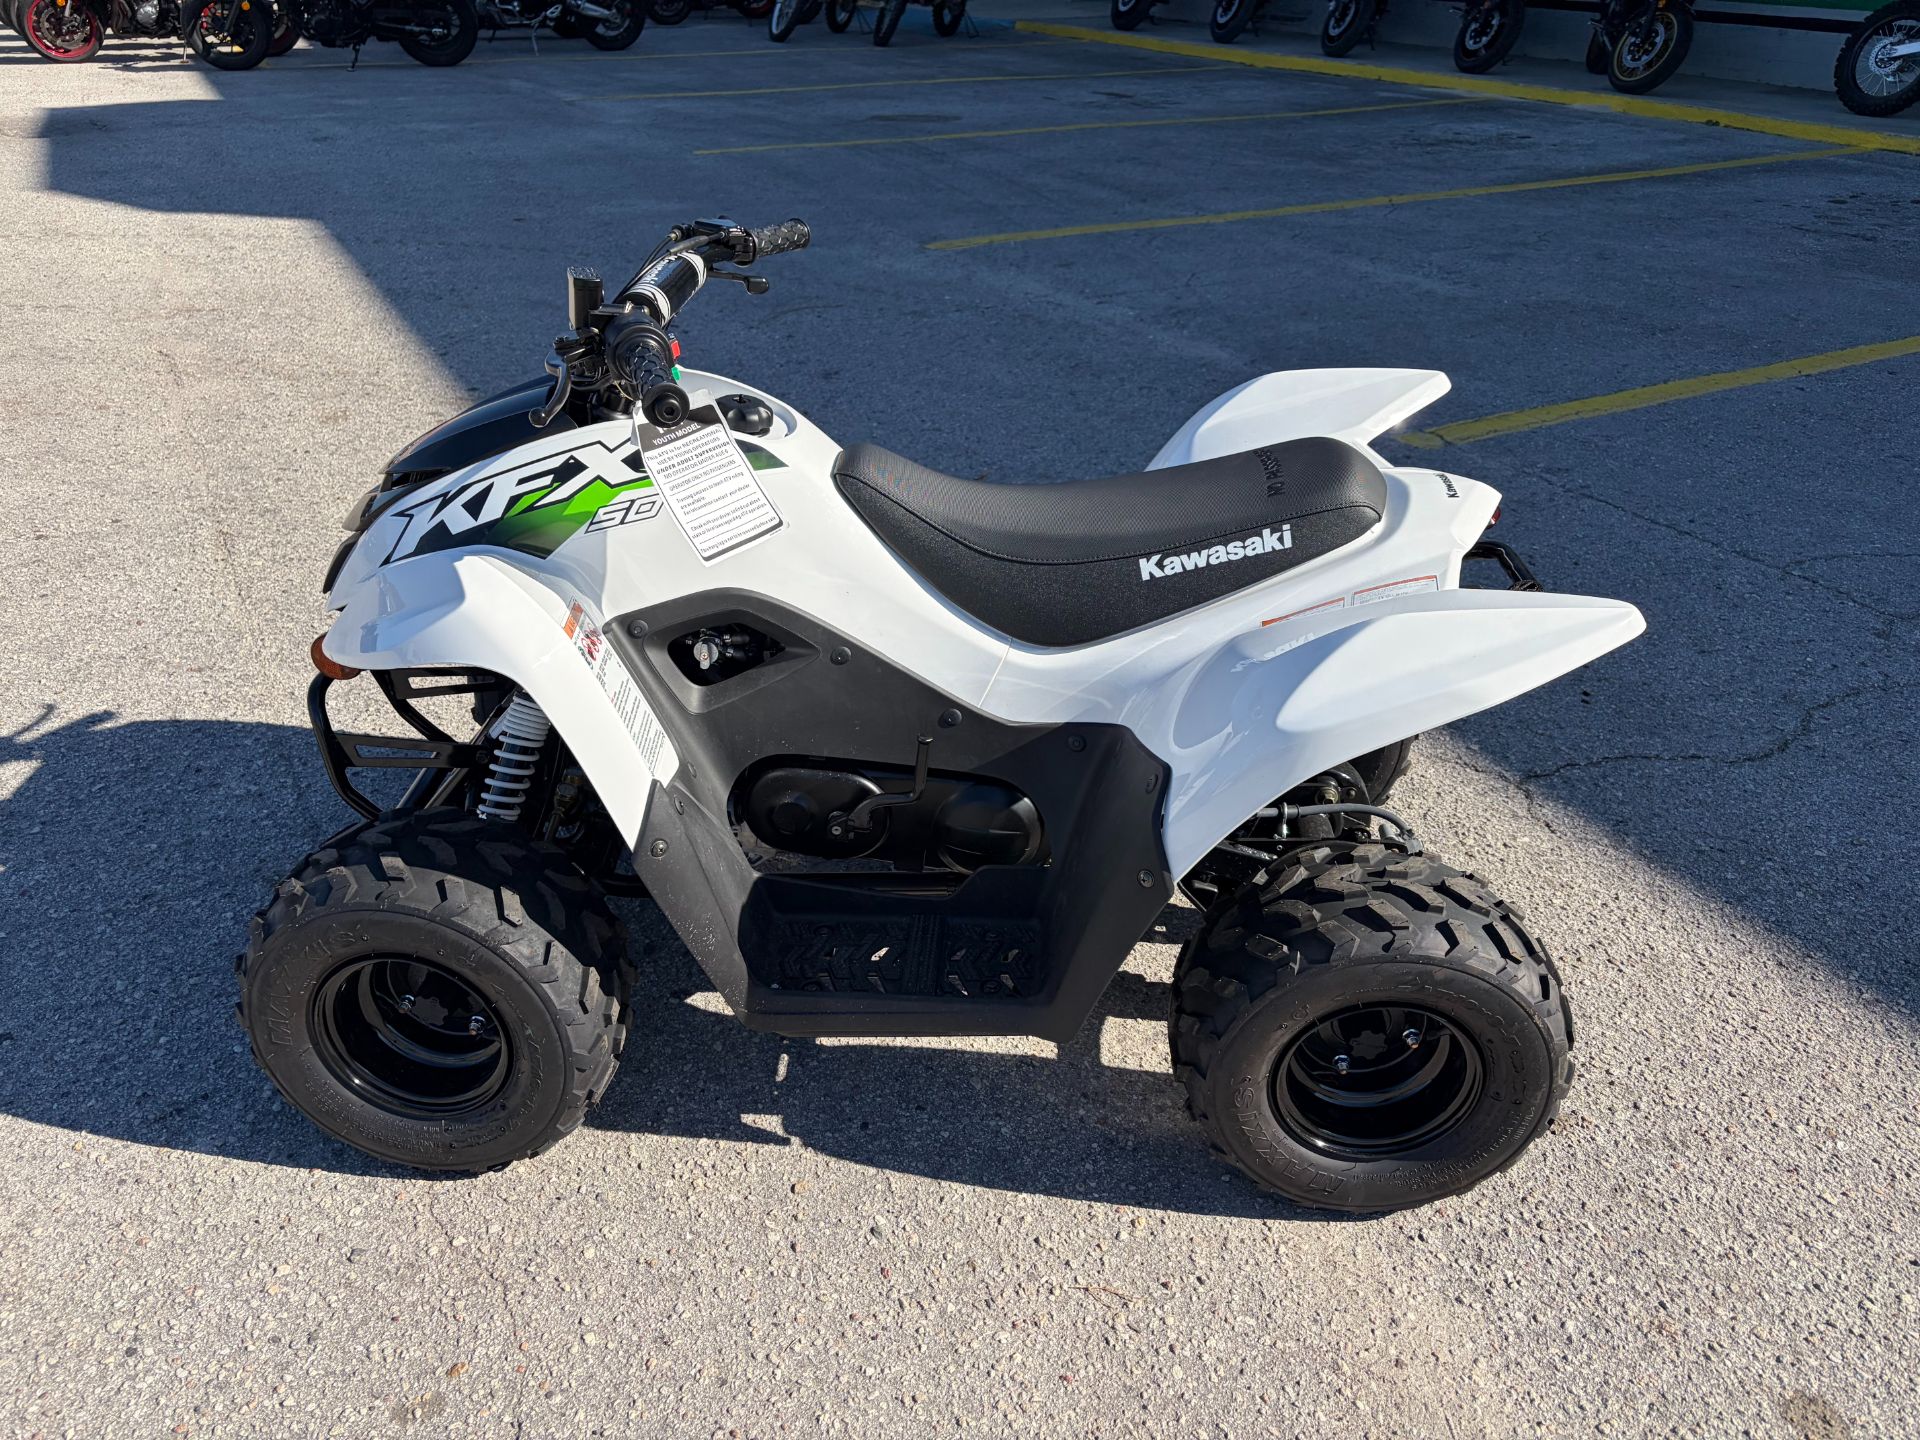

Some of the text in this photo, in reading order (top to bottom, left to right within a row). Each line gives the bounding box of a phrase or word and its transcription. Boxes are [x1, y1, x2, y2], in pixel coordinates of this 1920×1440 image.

[652, 431, 676, 446] YOUTH
[674, 421, 701, 436] MODEL
[656, 457, 668, 465] USE
[673, 447, 692, 458] YOUNG
[690, 435, 720, 451] OPERATORS
[680, 427, 722, 447] RECREATIONAL
[655, 440, 730, 474] UNDER ADULT SUPERVISION
[671, 461, 698, 476] OPERATOR
[696, 453, 716, 465] UNDER
[714, 449, 725, 457] AGE
[380, 437, 645, 566] KFX
[584, 493, 665, 535] 50
[1138, 523, 1293, 582] Kawasaki
[1233, 1086, 1348, 1194] MAXXIS
